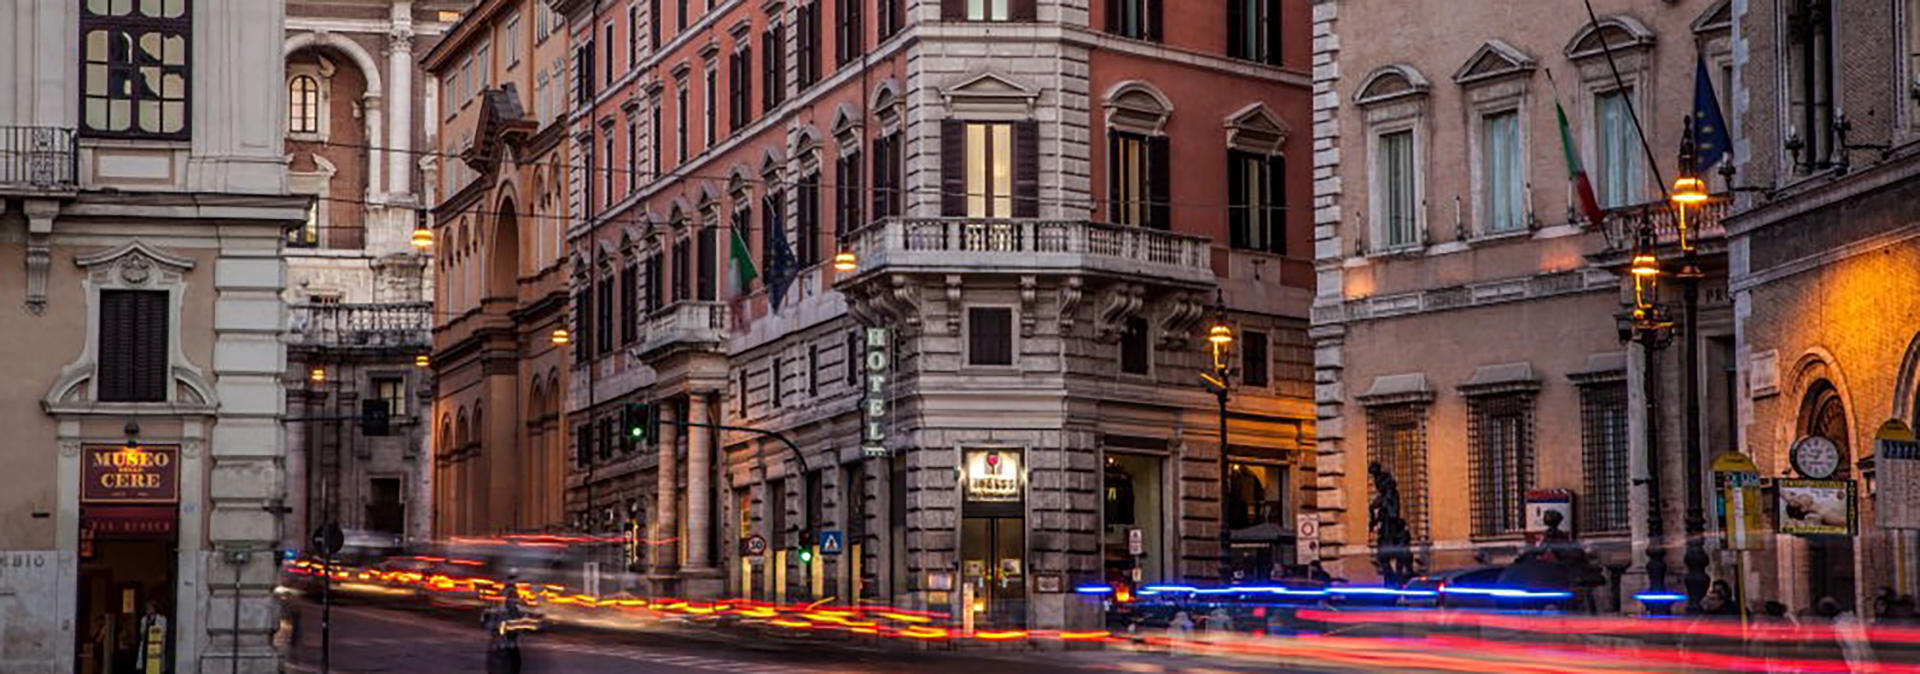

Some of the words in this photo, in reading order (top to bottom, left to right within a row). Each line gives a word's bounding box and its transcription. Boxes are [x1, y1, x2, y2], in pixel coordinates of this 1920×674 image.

[867, 328, 886, 440] HOTEL
[93, 452, 169, 467] MUSEO
[101, 473, 160, 488] CERE
